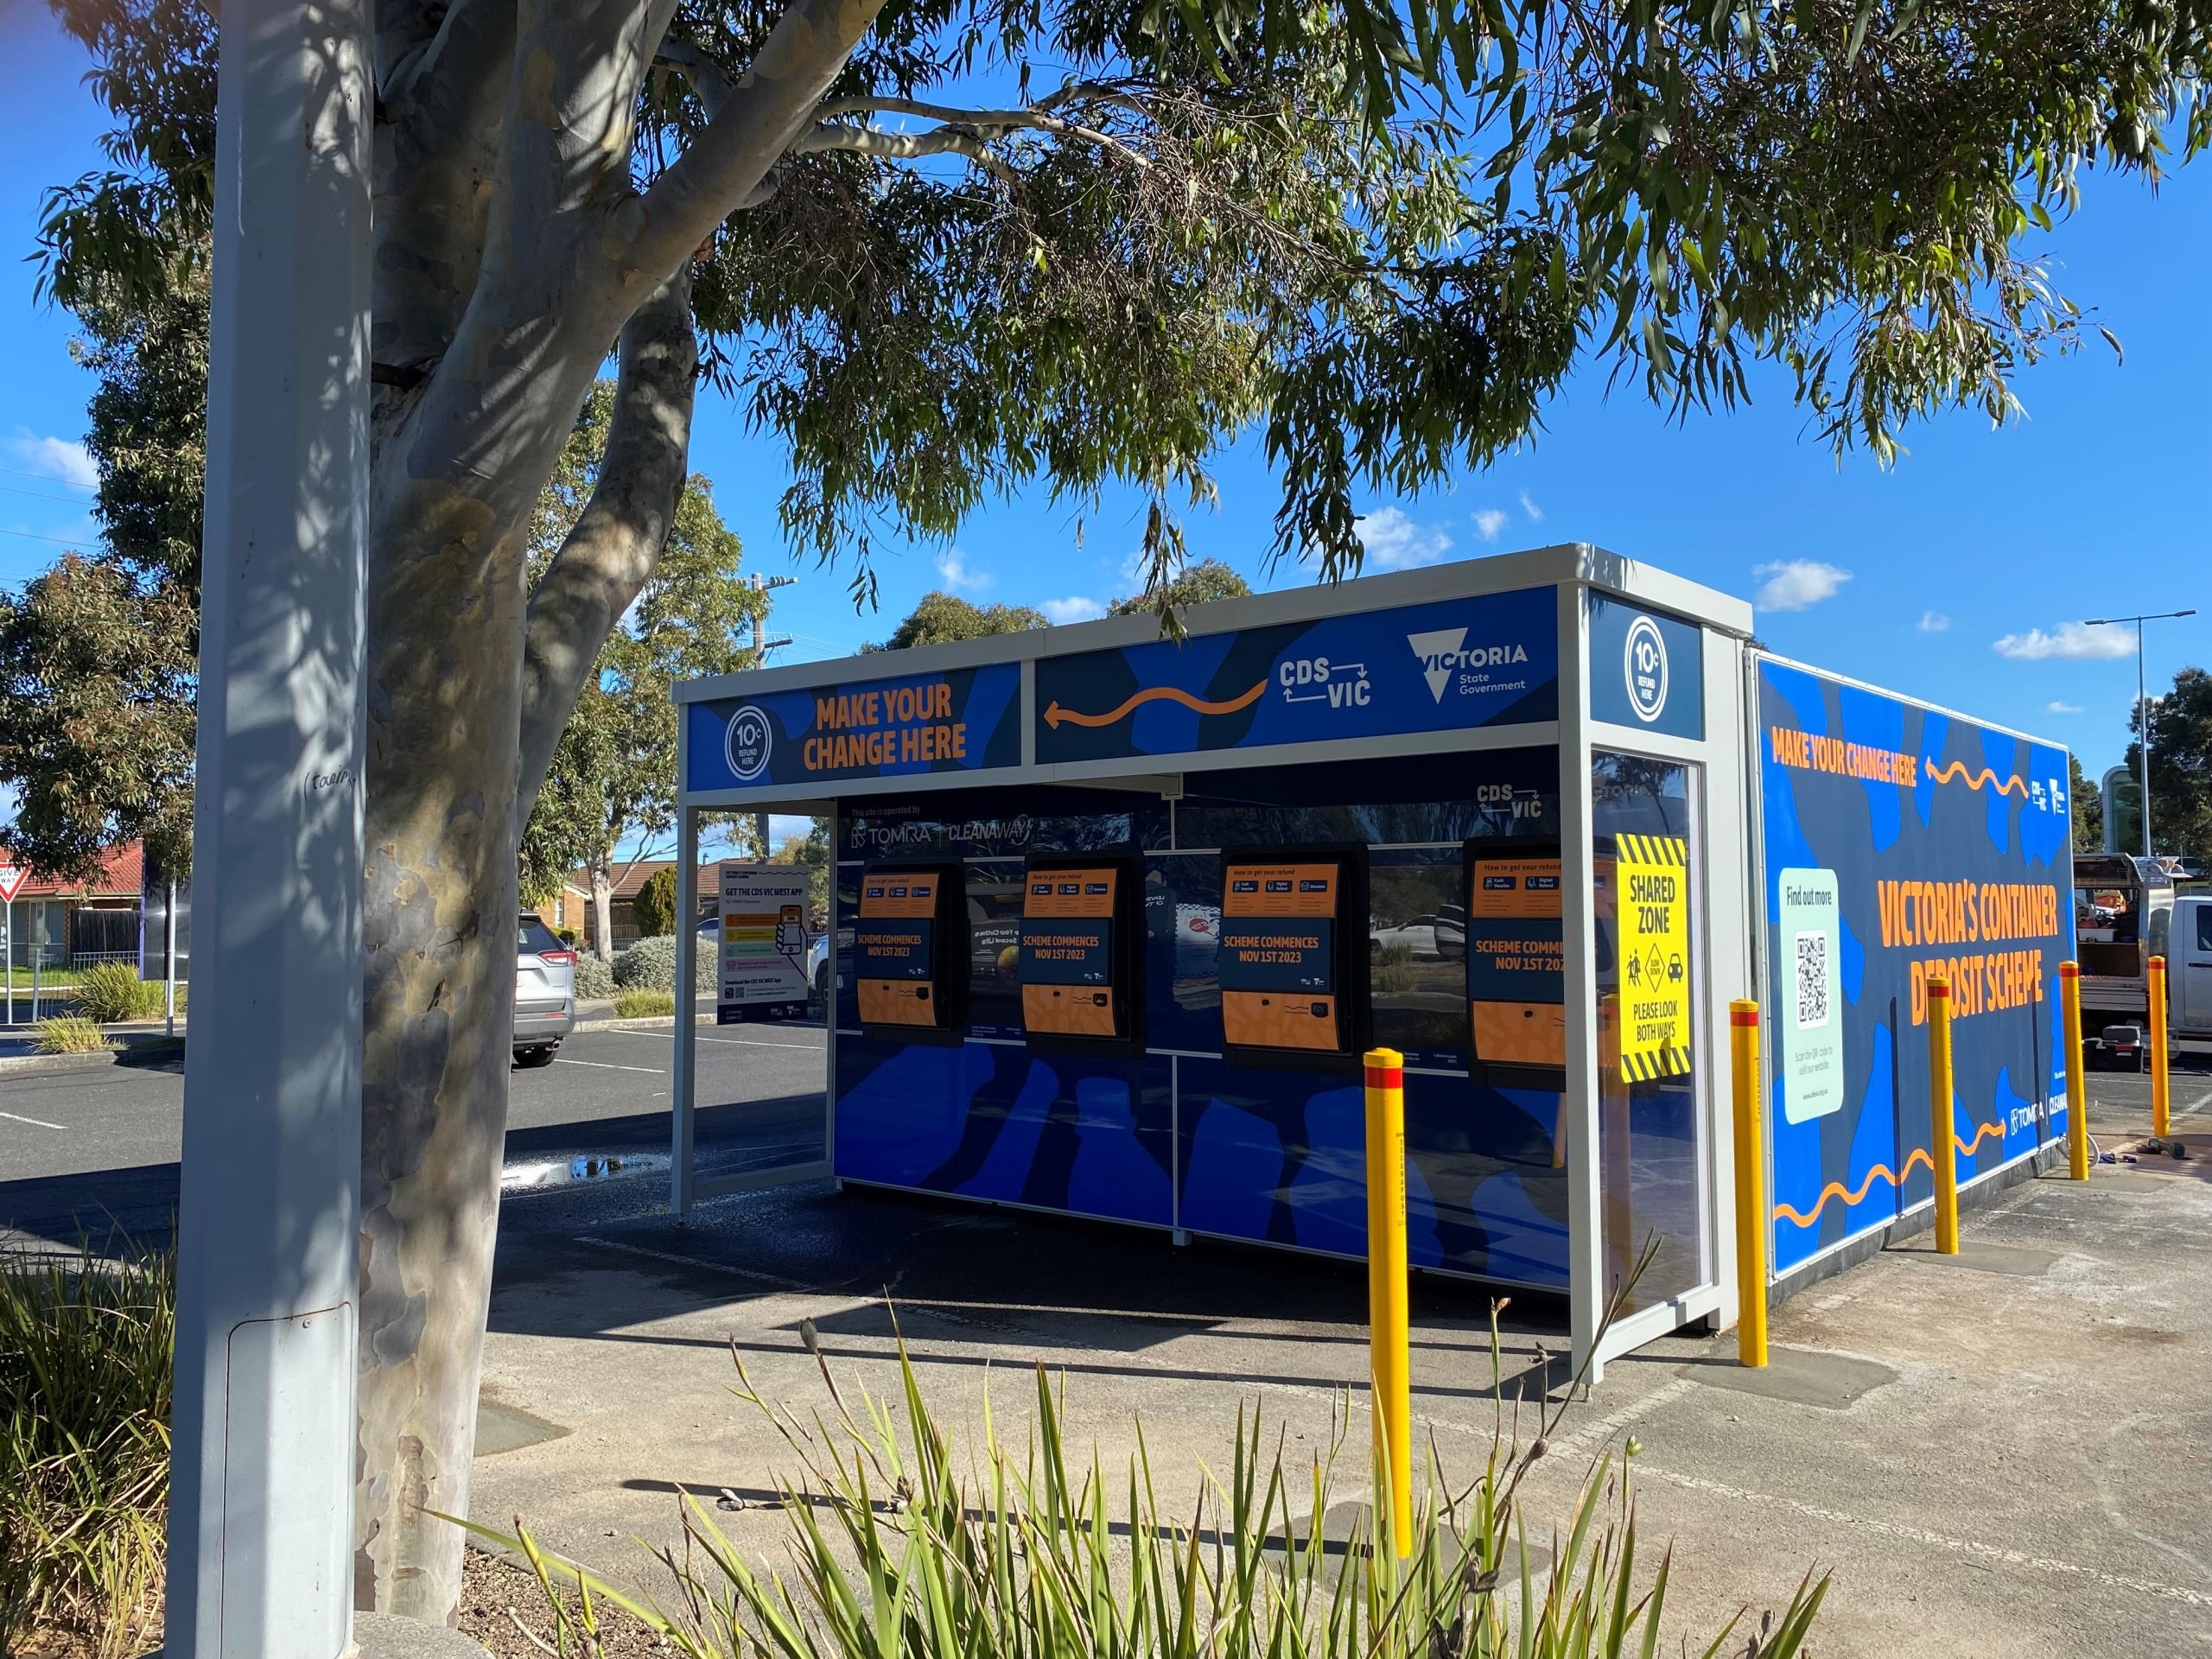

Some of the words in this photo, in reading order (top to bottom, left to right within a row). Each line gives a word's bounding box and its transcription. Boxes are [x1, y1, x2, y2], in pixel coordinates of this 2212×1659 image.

[1420, 644, 1529, 671] VICTORIA
[1280, 658, 1331, 687] CDS
[1459, 673, 1490, 683] State
[1327, 679, 1371, 709] VIC
[1459, 680, 1526, 695] Government
[817, 692, 879, 730] MAKE
[883, 683, 952, 723] YOUR
[739, 748, 758, 757] REFUND
[804, 730, 896, 770] CHANGE
[901, 723, 966, 763] HERE
[741, 757, 754, 766] HERE
[1772, 726, 1809, 768] MAKE
[1810, 734, 1846, 775] YOUR
[1847, 741, 1890, 783] CHANGE
[1891, 753, 1916, 787] HERE
[1477, 784, 1513, 802] CDS
[1593, 783, 1652, 797] CTORIA
[865, 807, 876, 816] site
[877, 807, 882, 816] is
[883, 804, 912, 817] operated
[912, 804, 920, 815] by
[1511, 800, 1542, 817] VIC
[868, 827, 932, 844] TOMRA
[949, 822, 1026, 841] CLEANAWAY
[1630, 874, 1675, 903] SHARED
[1787, 885, 1802, 906] Find
[1803, 888, 1814, 906] out
[1815, 891, 1832, 906] more
[1638, 906, 1669, 934] ZONE
[1878, 879, 1978, 947] VICTORIA'S
[1980, 883, 2057, 941] CONTAINER
[857, 934, 882, 944] SCHEME
[882, 935, 922, 944] COMMENCES
[1023, 936, 1052, 946] SCHEME
[1052, 936, 1099, 947] COMMENCES
[1224, 937, 1259, 947] SCHEME
[1261, 937, 1319, 949] COMMENCES
[1476, 940, 1521, 953] SCHEME
[868, 946, 881, 957] NOV
[882, 947, 893, 957] 1ST
[894, 947, 910, 957] 2023
[1035, 950, 1052, 959] NOV
[1052, 950, 1065, 959] 1ST
[1066, 950, 1085, 960] 2023
[1240, 951, 1259, 962] NOV
[1261, 951, 1277, 962] 1ST
[1278, 952, 1301, 963] 2023
[1496, 957, 1521, 969] NOV
[1522, 957, 1543, 970] 1ST
[1545, 958, 1563, 971] 202
[1910, 955, 1984, 1026] DOSIT
[1986, 950, 2043, 1012] SCHEME
[1633, 1001, 1658, 1020] PLEASE
[1659, 1000, 1678, 1018] LOOK
[1637, 1023, 1656, 1042] BOTH
[1657, 1021, 1675, 1039] WAYS
